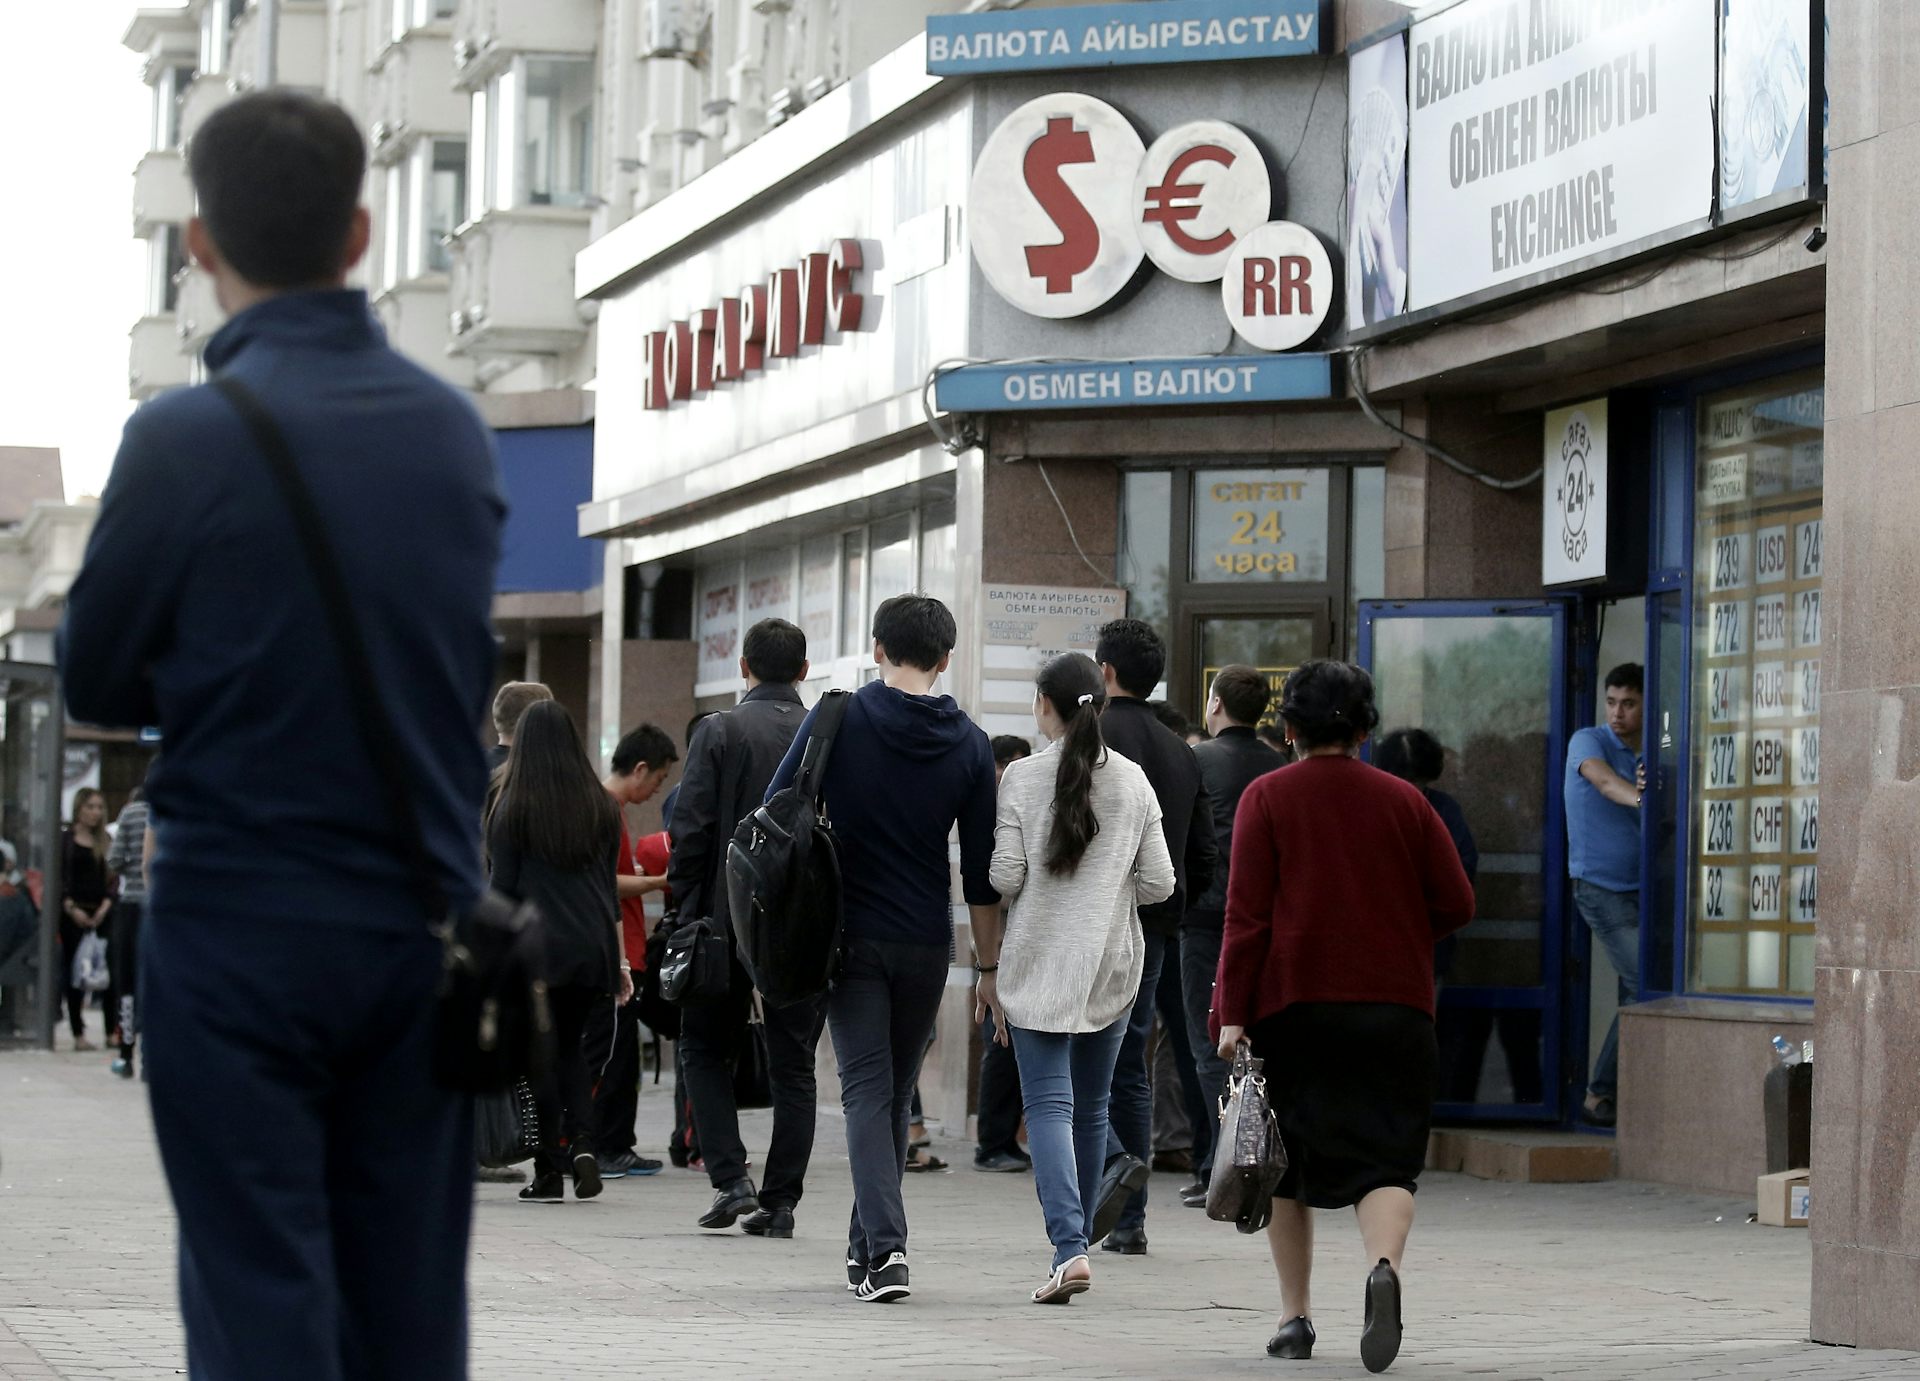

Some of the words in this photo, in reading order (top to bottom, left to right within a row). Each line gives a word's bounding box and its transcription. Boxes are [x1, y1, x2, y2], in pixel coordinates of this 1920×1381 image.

[929, 28, 1070, 62] ВАЛЮТА
[1081, 13, 1315, 53] АЙЫРБАСТАУ
[1416, 2, 1521, 110] ВАЛЮТА
[1449, 96, 1537, 190] ОБМЕН
[1544, 43, 1658, 159] ВАЛЮТЫ
[1023, 117, 1101, 294] $
[1490, 164, 1617, 273] EXCHANGE
[1243, 255, 1313, 317] RR
[643, 238, 863, 410] НОТАРИУС
[1004, 369, 1121, 402] ОБМЕН
[1134, 366, 1258, 397] ВАЛЮТ
[1567, 469, 1585, 513] 24
[1229, 511, 1281, 545] 24
[1215, 551, 1297, 575] часа
[1715, 537, 1739, 588] 239
[1758, 535, 1786, 575] USD
[989, 590, 1037, 600] ВАЛЮТА
[1005, 603, 1046, 614] ОБМЕН
[1050, 605, 1100, 616] ВАЛЮТЫ
[1714, 602, 1739, 653] 272
[1756, 602, 1784, 641] EUR
[1755, 669, 1784, 710] RUR
[1711, 736, 1737, 785] 372
[1753, 739, 1783, 777] GBP
[1708, 802, 1733, 851] 236
[1754, 806, 1782, 843] CHF
[1707, 868, 1724, 917] 32
[1751, 875, 1781, 912] CHY
